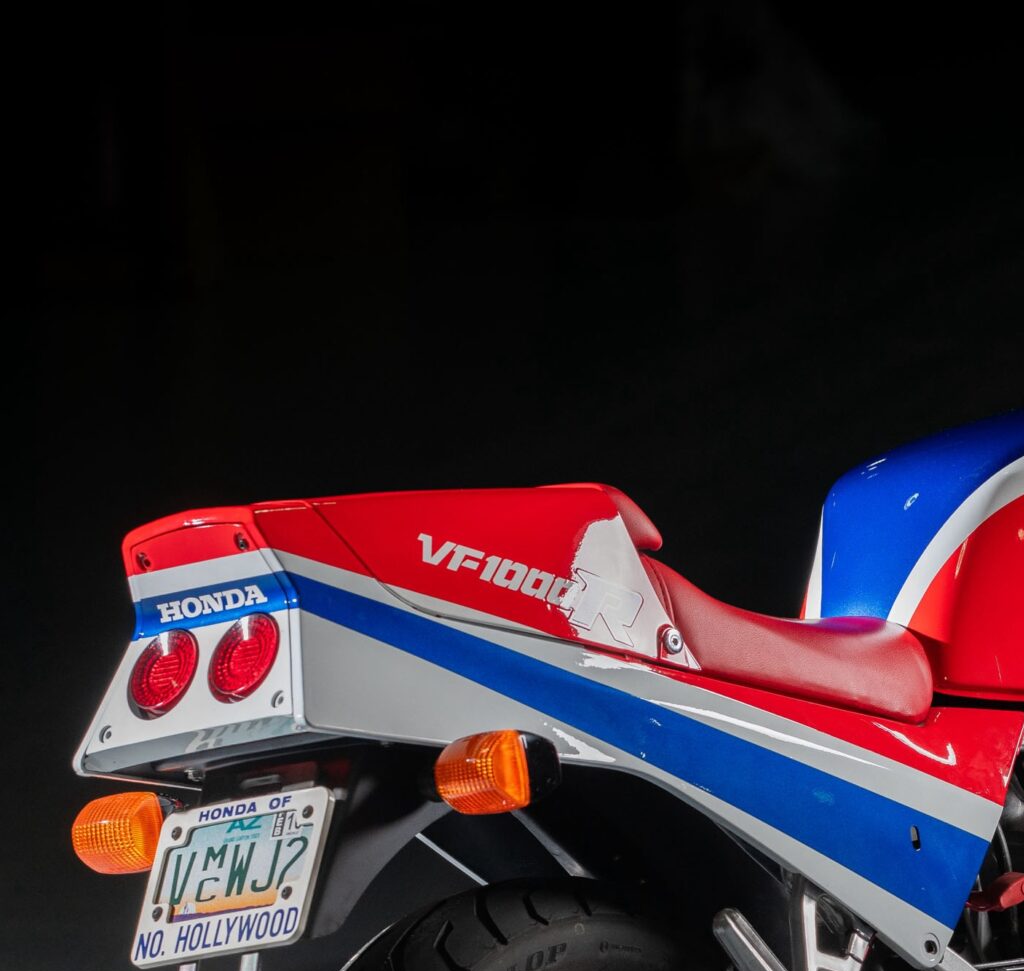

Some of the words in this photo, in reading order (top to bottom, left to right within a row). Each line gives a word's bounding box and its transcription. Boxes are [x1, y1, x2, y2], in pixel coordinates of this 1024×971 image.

[157, 584, 268, 624] HONDA
[198, 802, 257, 823] HONDA
[268, 795, 293, 810] OF
[134, 929, 165, 961] NO.
[174, 907, 299, 954] HOLLYWOOD
